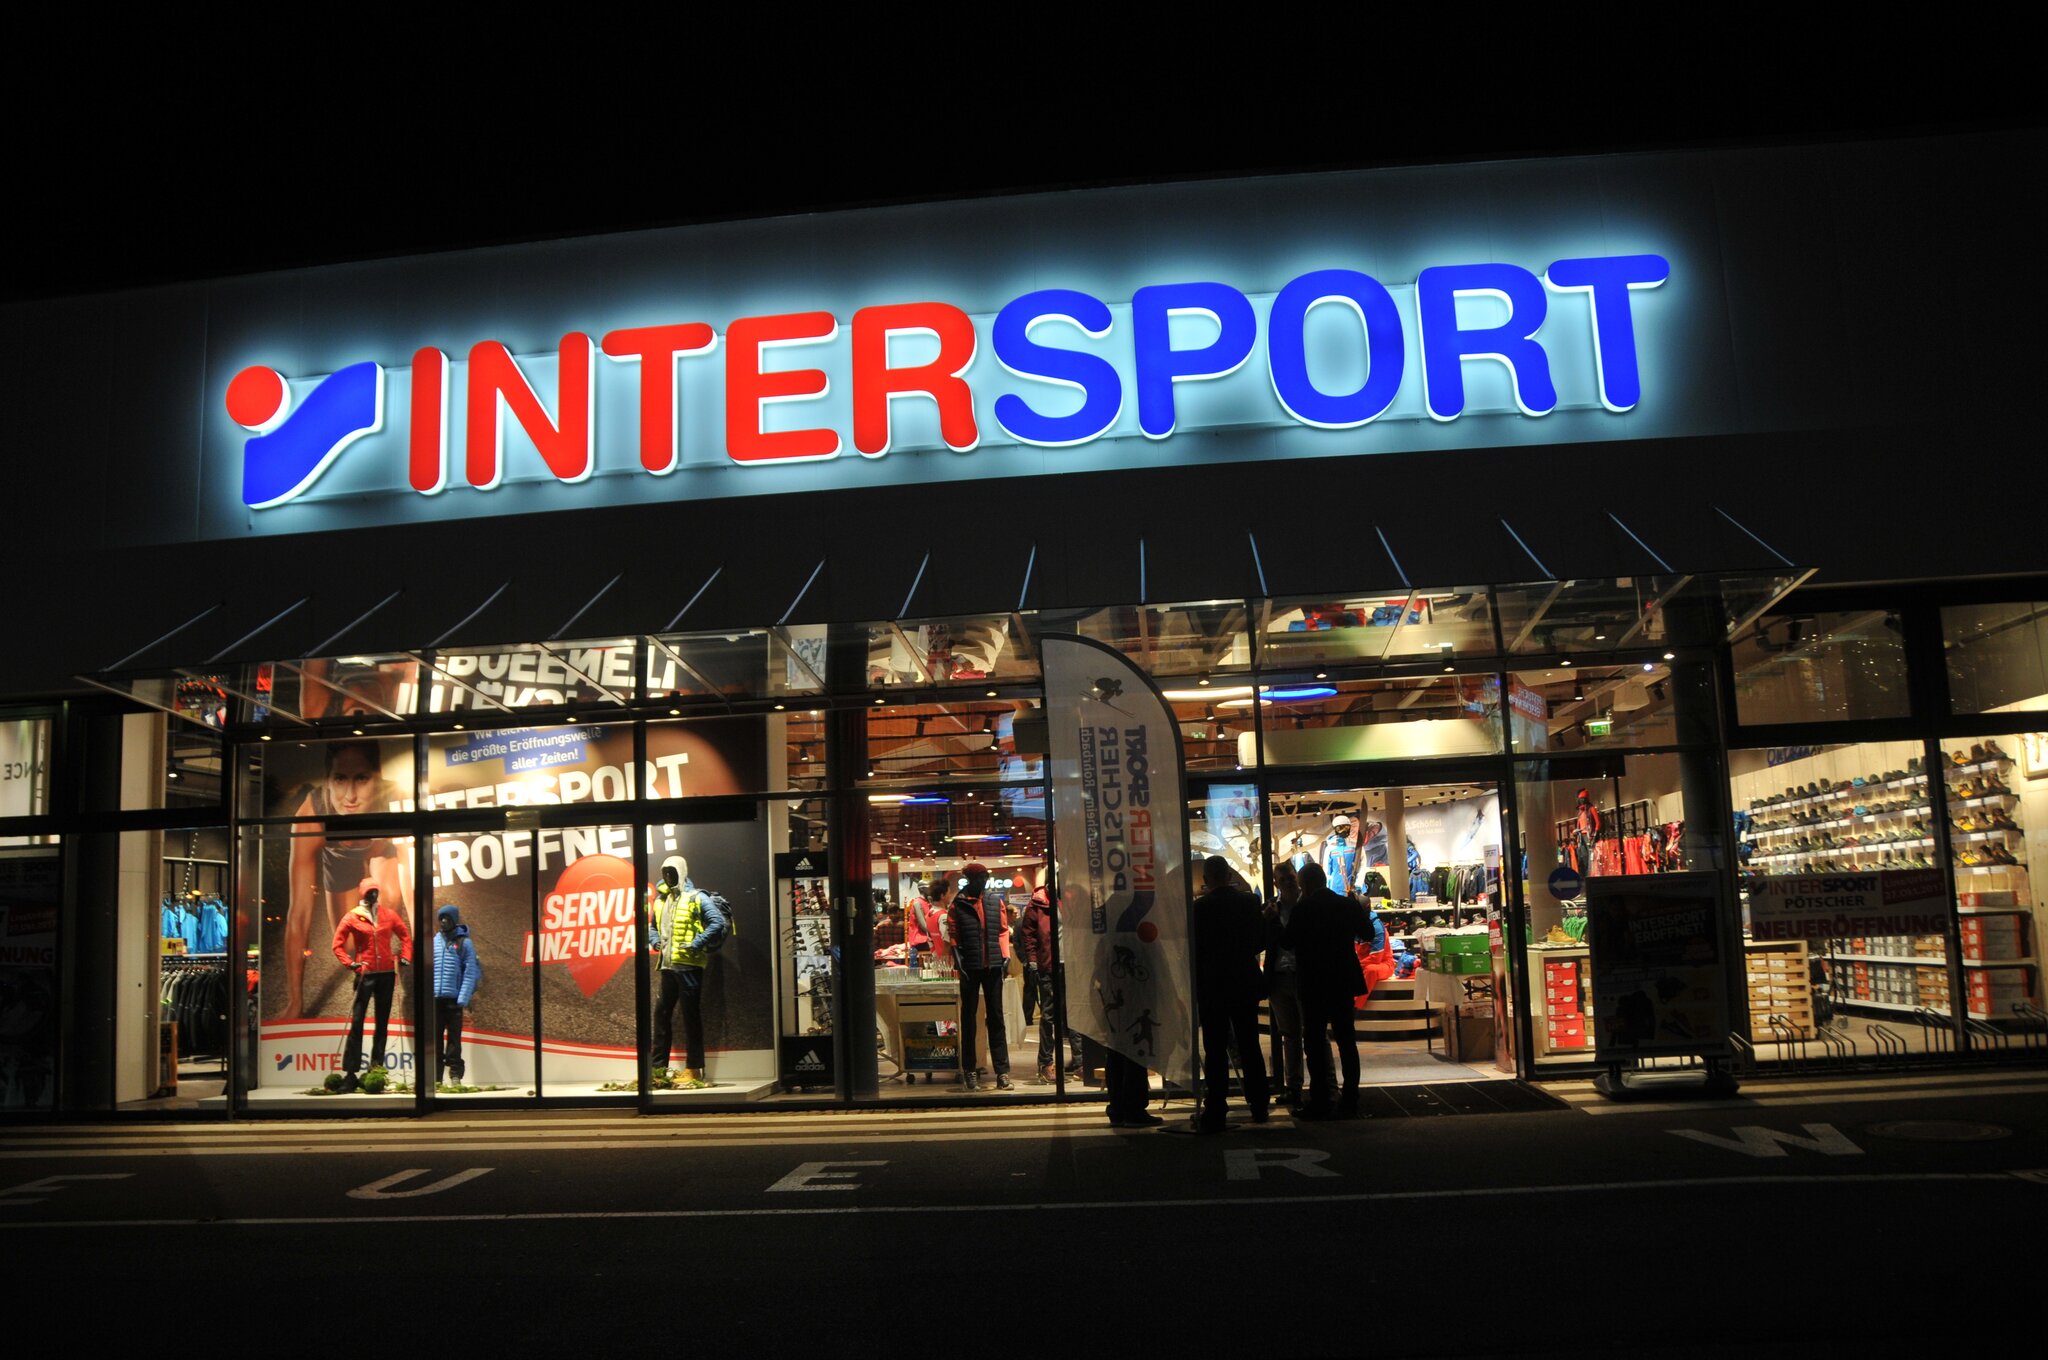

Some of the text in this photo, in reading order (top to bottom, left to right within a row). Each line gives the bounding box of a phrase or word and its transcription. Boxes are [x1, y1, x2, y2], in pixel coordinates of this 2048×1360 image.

[408, 253, 1670, 495] INTERSPORT
[452, 727, 602, 762] die größte Eröffnungswelle
[512, 748, 579, 770] aller Zeiten!
[1769, 876, 1878, 895] INTERSPORT
[1754, 914, 1946, 940] NEUERÖFFNUNG
[296, 1052, 415, 1072] INTESOR
